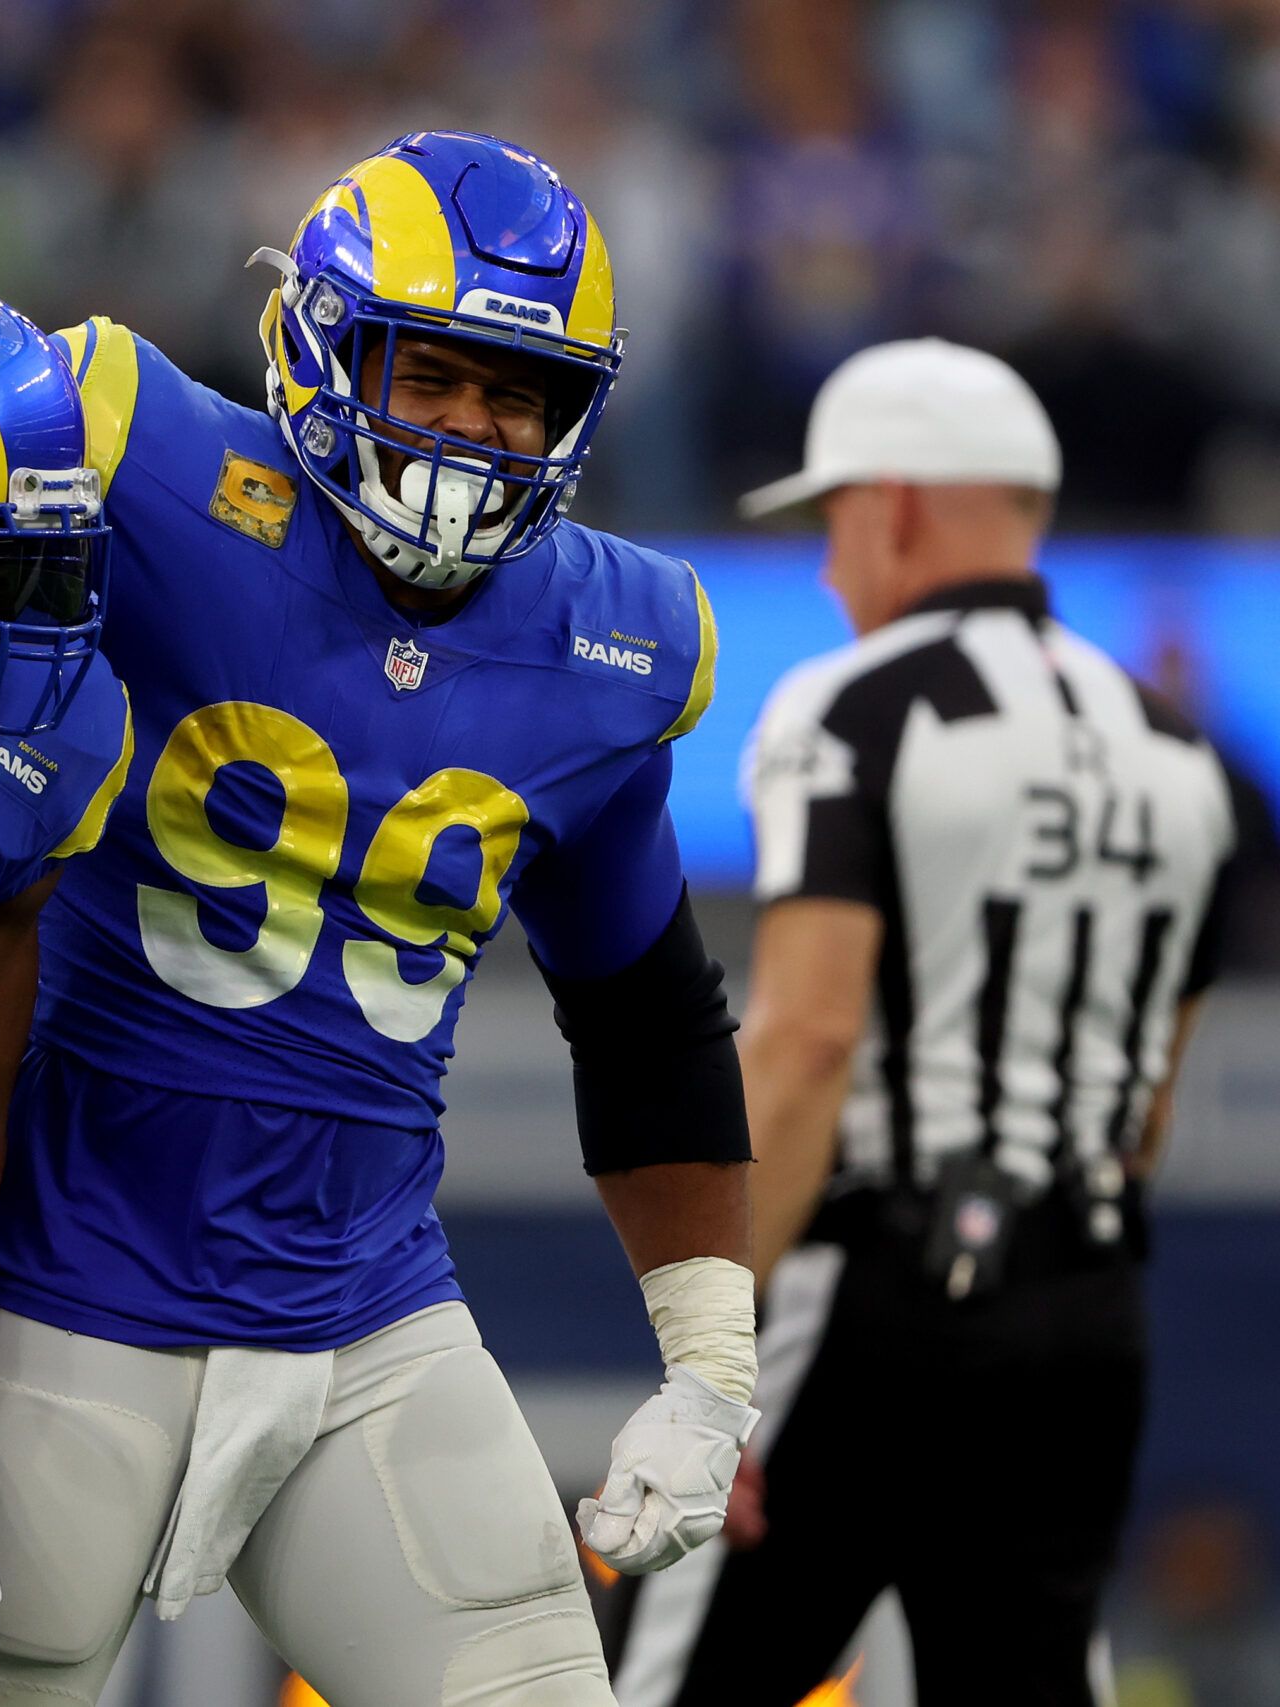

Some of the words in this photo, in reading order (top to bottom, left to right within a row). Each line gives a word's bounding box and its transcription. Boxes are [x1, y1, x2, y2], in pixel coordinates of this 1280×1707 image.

[485, 298, 551, 324] RAMS
[224, 460, 292, 523] C
[390, 657, 417, 684] NFL
[573, 635, 653, 675] RAMS
[1025, 785, 1160, 883] 34
[137, 701, 530, 1043] 99
